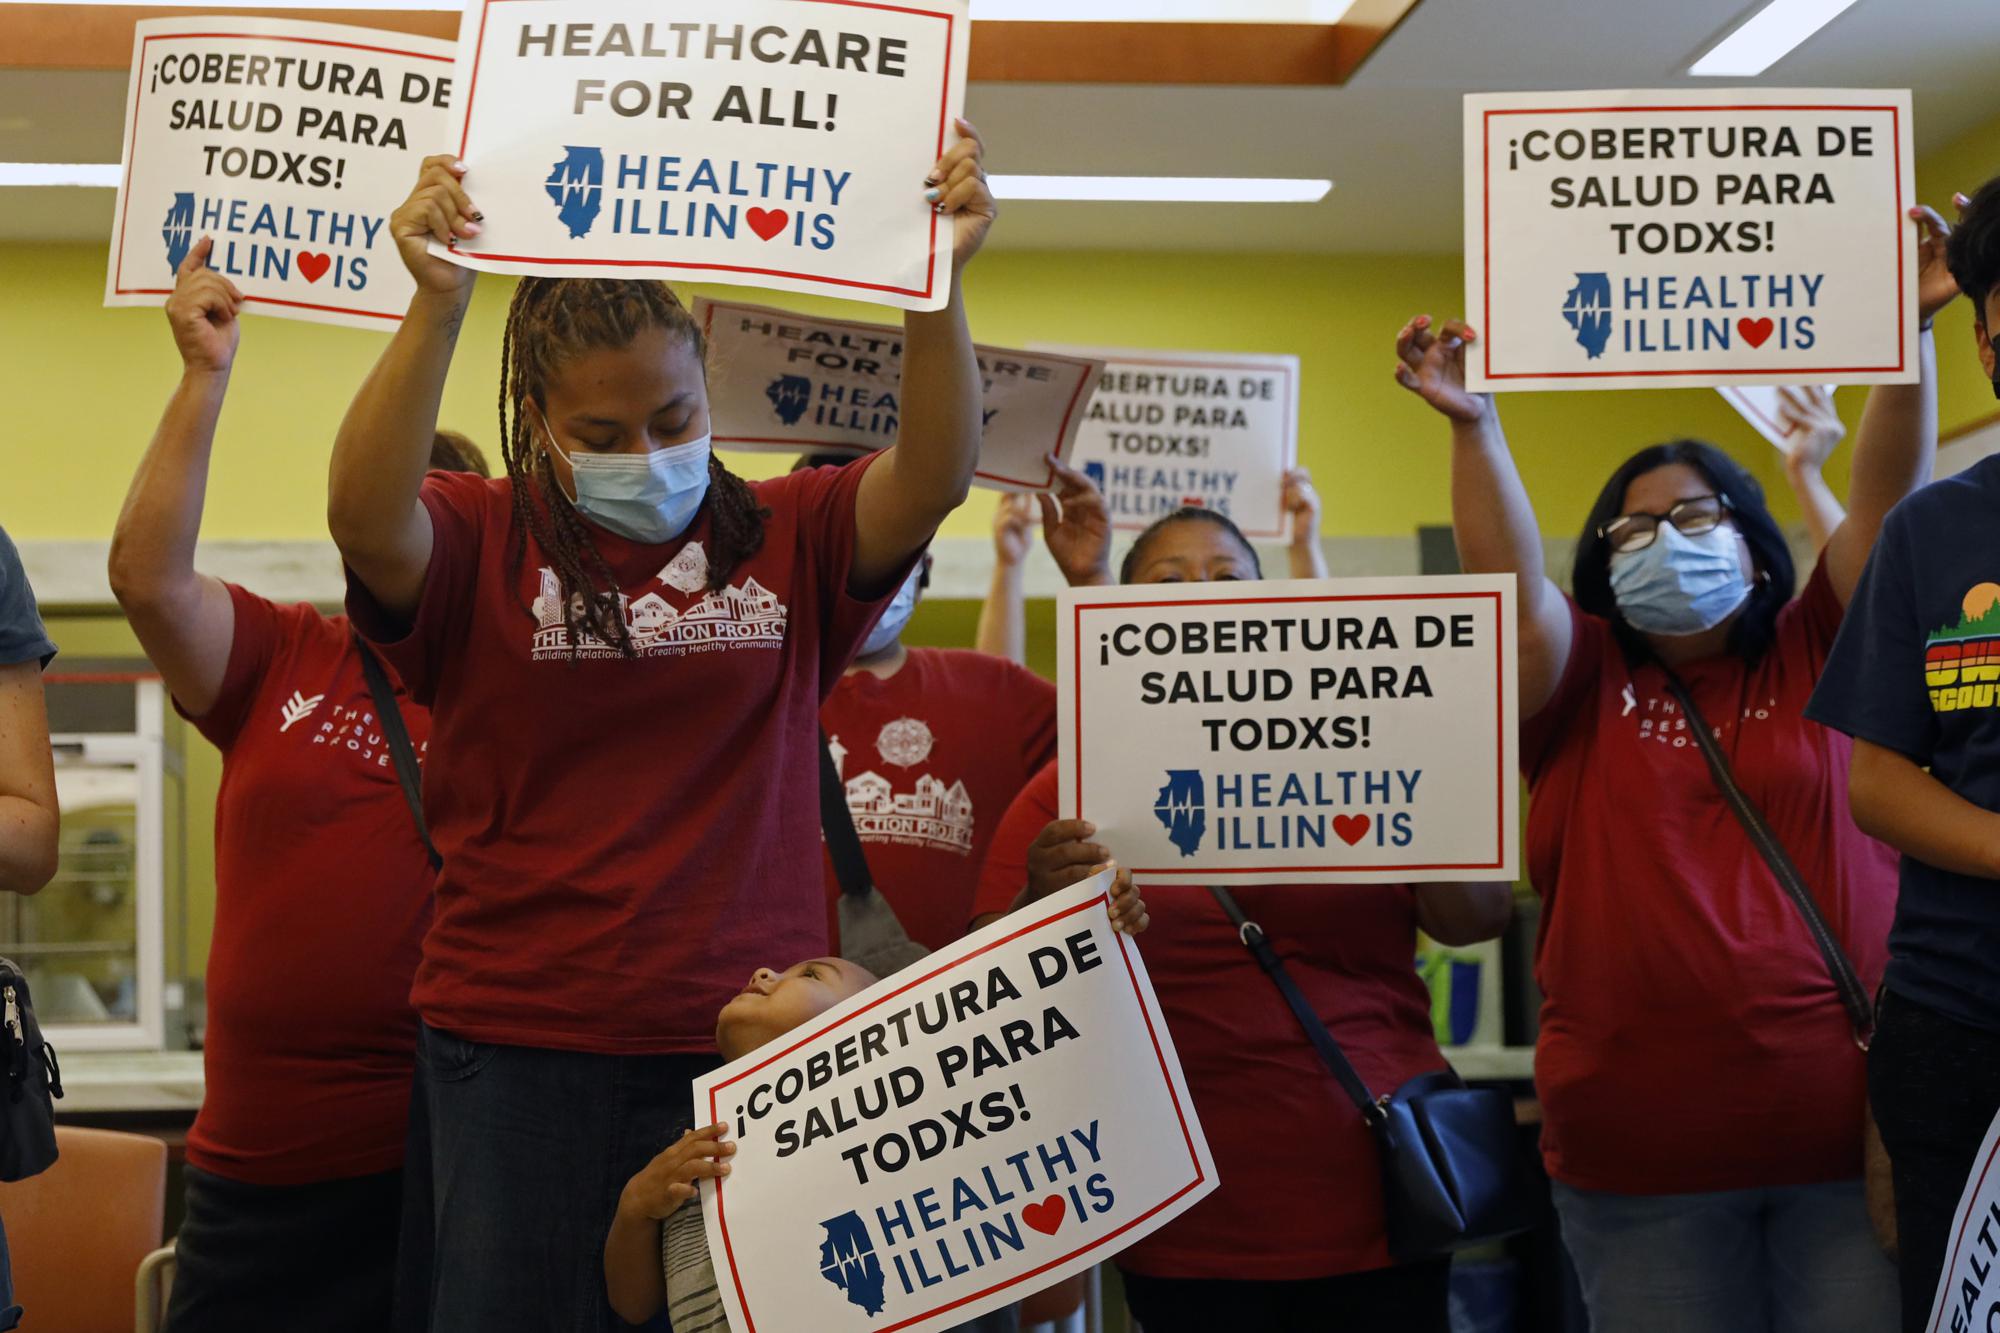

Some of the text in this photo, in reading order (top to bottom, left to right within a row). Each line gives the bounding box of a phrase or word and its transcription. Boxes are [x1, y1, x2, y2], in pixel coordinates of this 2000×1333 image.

[517, 22, 909, 78] HEALTHCARE
[151, 54, 452, 108] ¡COBERTURA DE
[169, 99, 407, 150] SALUD PARA
[573, 79, 838, 132] FOR ALL!
[203, 146, 345, 189] TODXS!
[1509, 126, 1874, 170] ¡COBERTURA DE
[617, 154, 852, 206] HEALTHY
[1550, 173, 1835, 208] SALUD PARA
[200, 198, 384, 250] HEALTHY
[1610, 221, 1775, 255] TODXS!
[1623, 274, 1825, 310] HEALTHY
[788, 347, 881, 375] FOR
[1239, 378, 1275, 400] DE
[1089, 402, 1247, 429] ALUD PARA
[1107, 431, 1211, 458] TODXS!
[1111, 464, 1238, 493] HEALTHY
[532, 649, 572, 661] Building
[648, 646, 686, 657] Creating
[689, 641, 727, 653] Healthy
[533, 631, 567, 648] THE
[1100, 614, 1475, 666] ¡COBERTURA DE
[1140, 664, 1433, 704] SALUD PARA
[1202, 715, 1372, 752] TODXS!
[1216, 769, 1422, 808] HEALTHY
[736, 928, 1103, 1139] ¡COBERTURA DE
[774, 1005, 1081, 1158] SALUD PARA
[840, 1083, 1033, 1185] TODXS!
[875, 1119, 1103, 1247] HEALTHY
